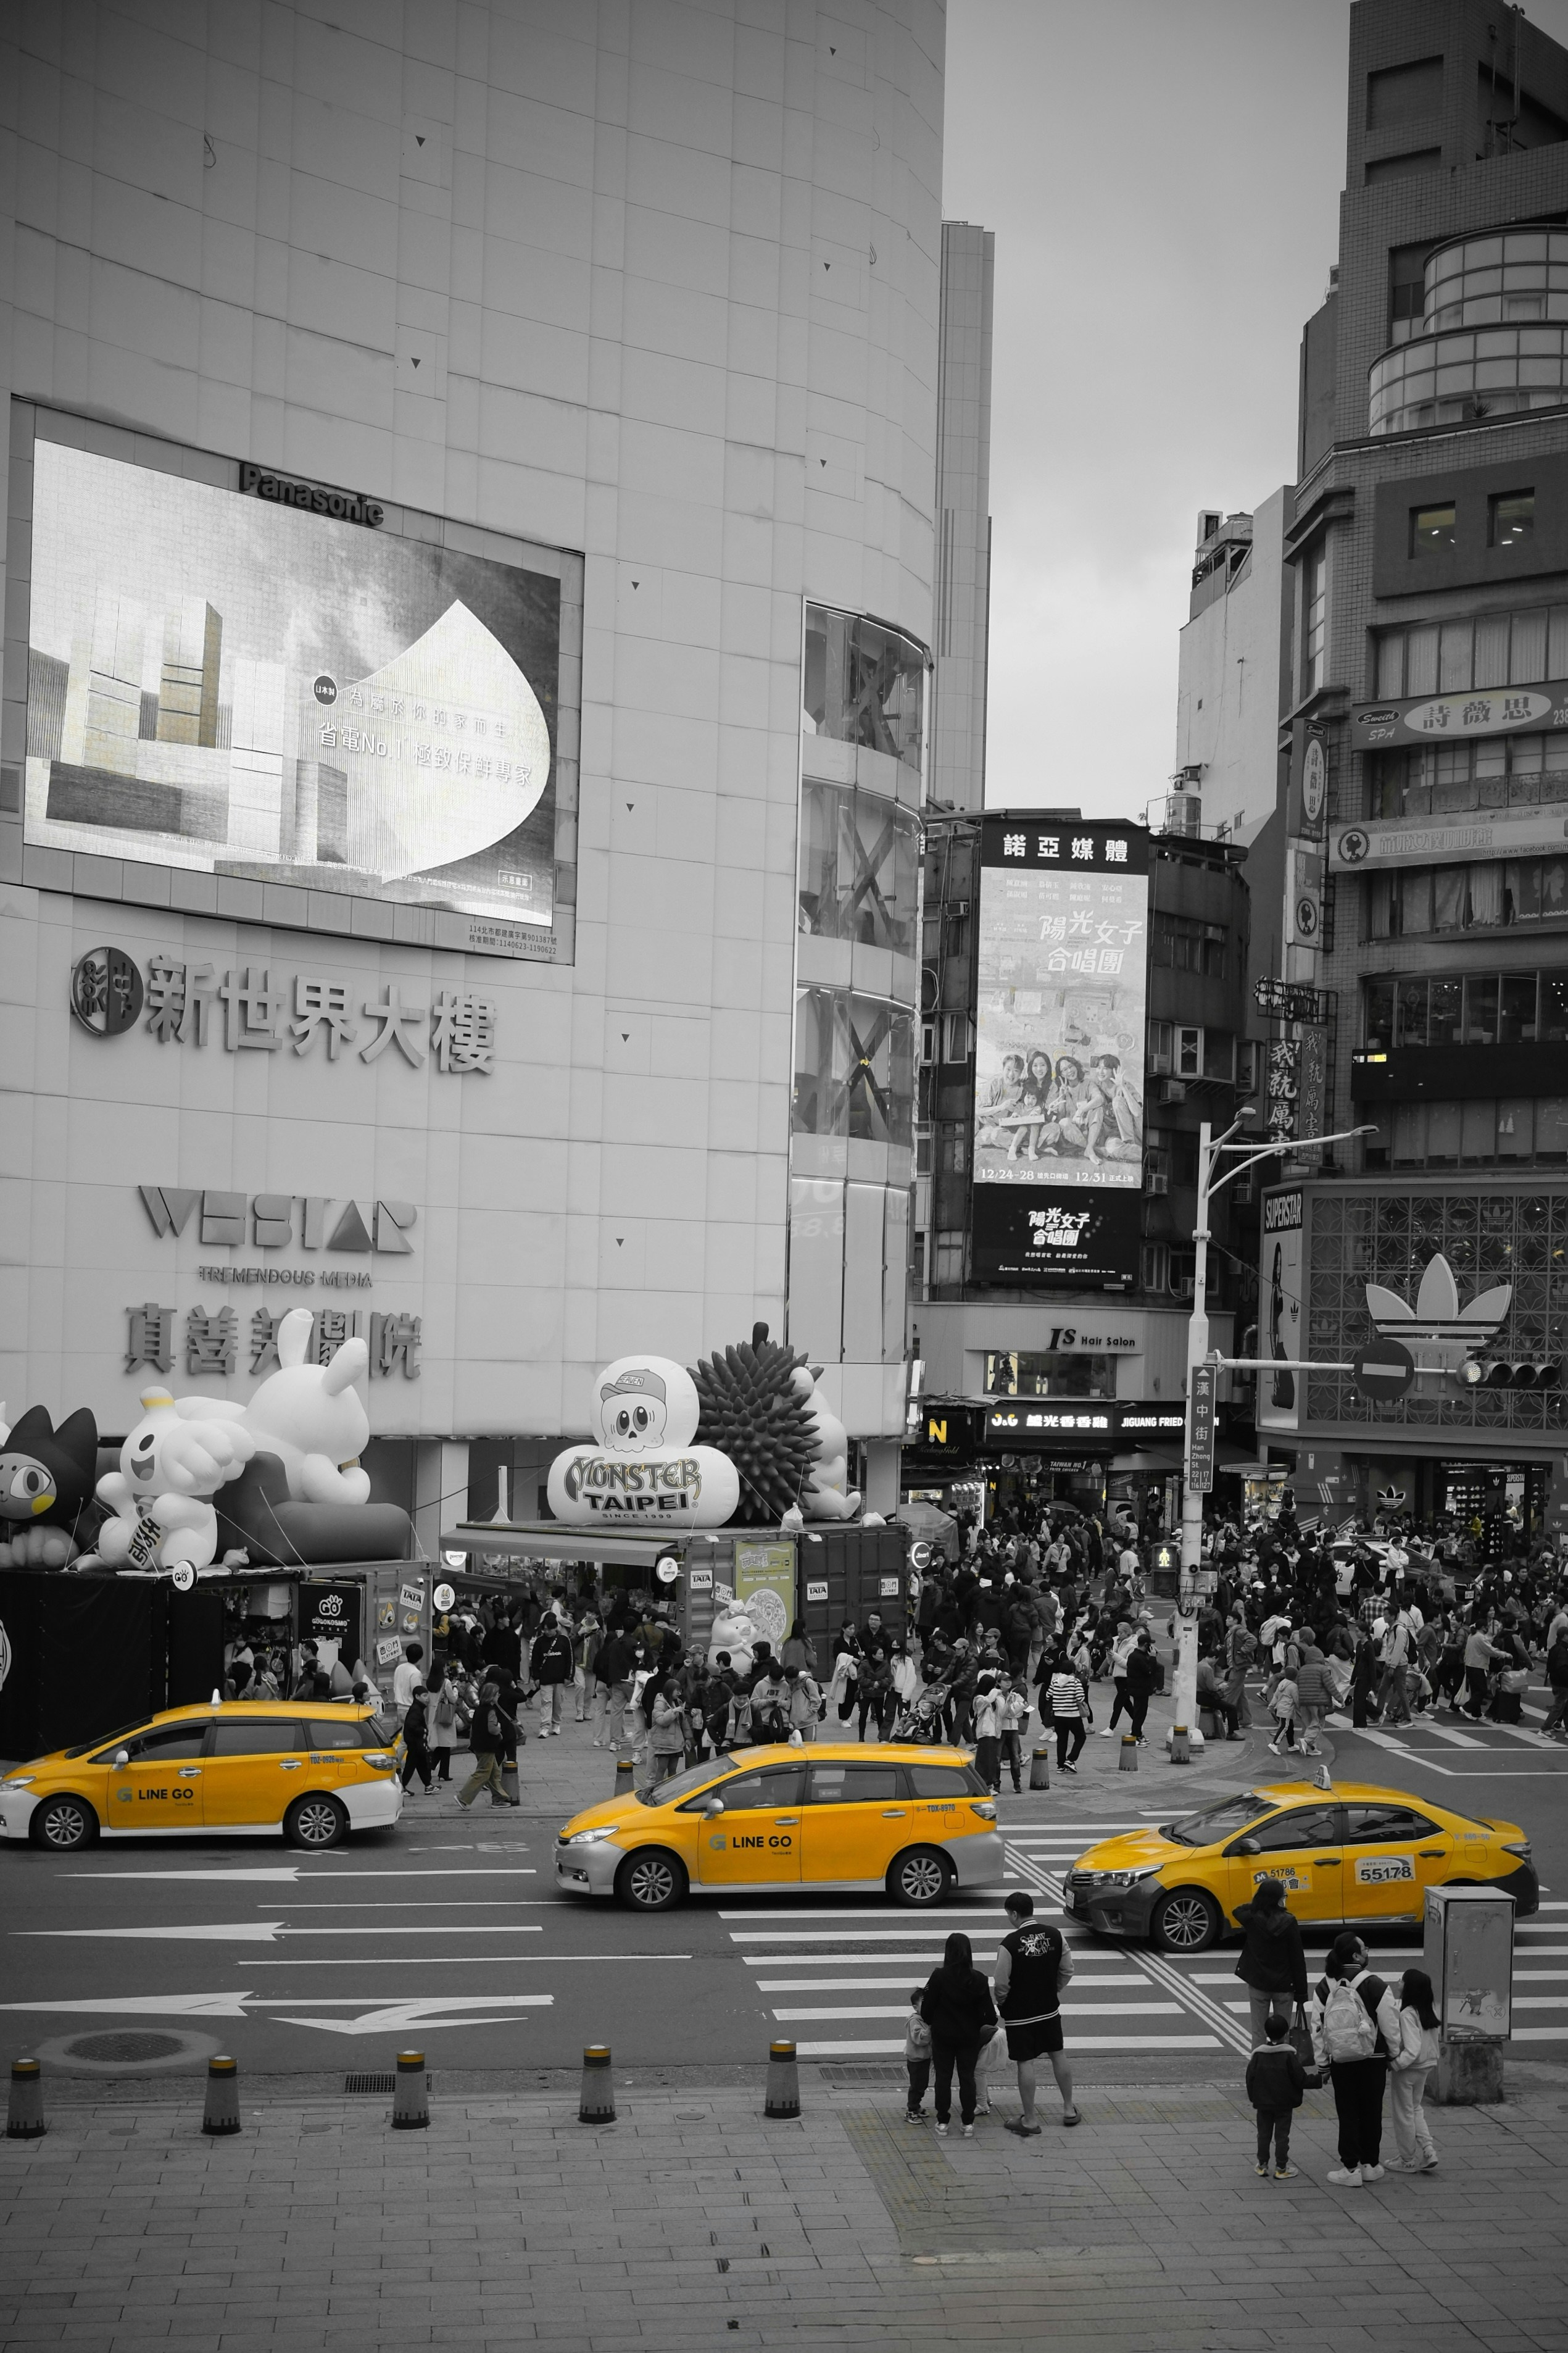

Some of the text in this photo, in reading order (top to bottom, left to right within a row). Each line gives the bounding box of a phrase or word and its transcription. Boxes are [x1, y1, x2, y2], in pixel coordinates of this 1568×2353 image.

[239, 464, 384, 527] Panasonic
[316, 684, 335, 697] 日本製
[350, 688, 509, 738] 為屬於你的家而生
[1423, 696, 1532, 729] 詩薇思
[1369, 728, 1396, 740] SPA
[413, 742, 531, 786] 極致保鮮專家
[1003, 834, 1128, 862] 諾亞媒體
[1039, 910, 1143, 945] 陽光女子
[1048, 947, 1126, 974] 合唱團
[147, 955, 495, 1075] 新世界大樓
[981, 1168, 1034, 1180] 12/24-28
[1076, 1172, 1106, 1183] 12/31
[138, 1185, 418, 1253] WESTAR
[1028, 1207, 1090, 1229] 陽光女子
[1266, 1193, 1302, 1229] SUPERSTAR
[1033, 1228, 1080, 1246] 合唱團
[199, 1265, 373, 1288] TREMENDOUS MEDIA
[1082, 1336, 1103, 1346] Hair
[1106, 1336, 1135, 1347] Salon
[618, 1375, 643, 1386] HEAVEN
[1195, 1381, 1210, 1441] 漢中街
[1121, 1417, 1158, 1428] JIGUANG
[1158, 1417, 1183, 1427] FRIED
[1072, 1460, 1087, 1469] NO.1
[1192, 1453, 1211, 1461] Zhong
[564, 1456, 702, 1502] MONSTER
[583, 1491, 689, 1512] TAIPEI
[692, 1575, 711, 1583] TATA
[403, 1588, 423, 1604] TATA
[808, 1586, 827, 1594] TATA
[139, 1789, 168, 1800] LINE
[172, 1788, 194, 1799] GO
[732, 1836, 764, 1848] LINE
[769, 1836, 792, 1847] GO
[1271, 1868, 1295, 1877] 51786
[1361, 1866, 1412, 1881] 55178
